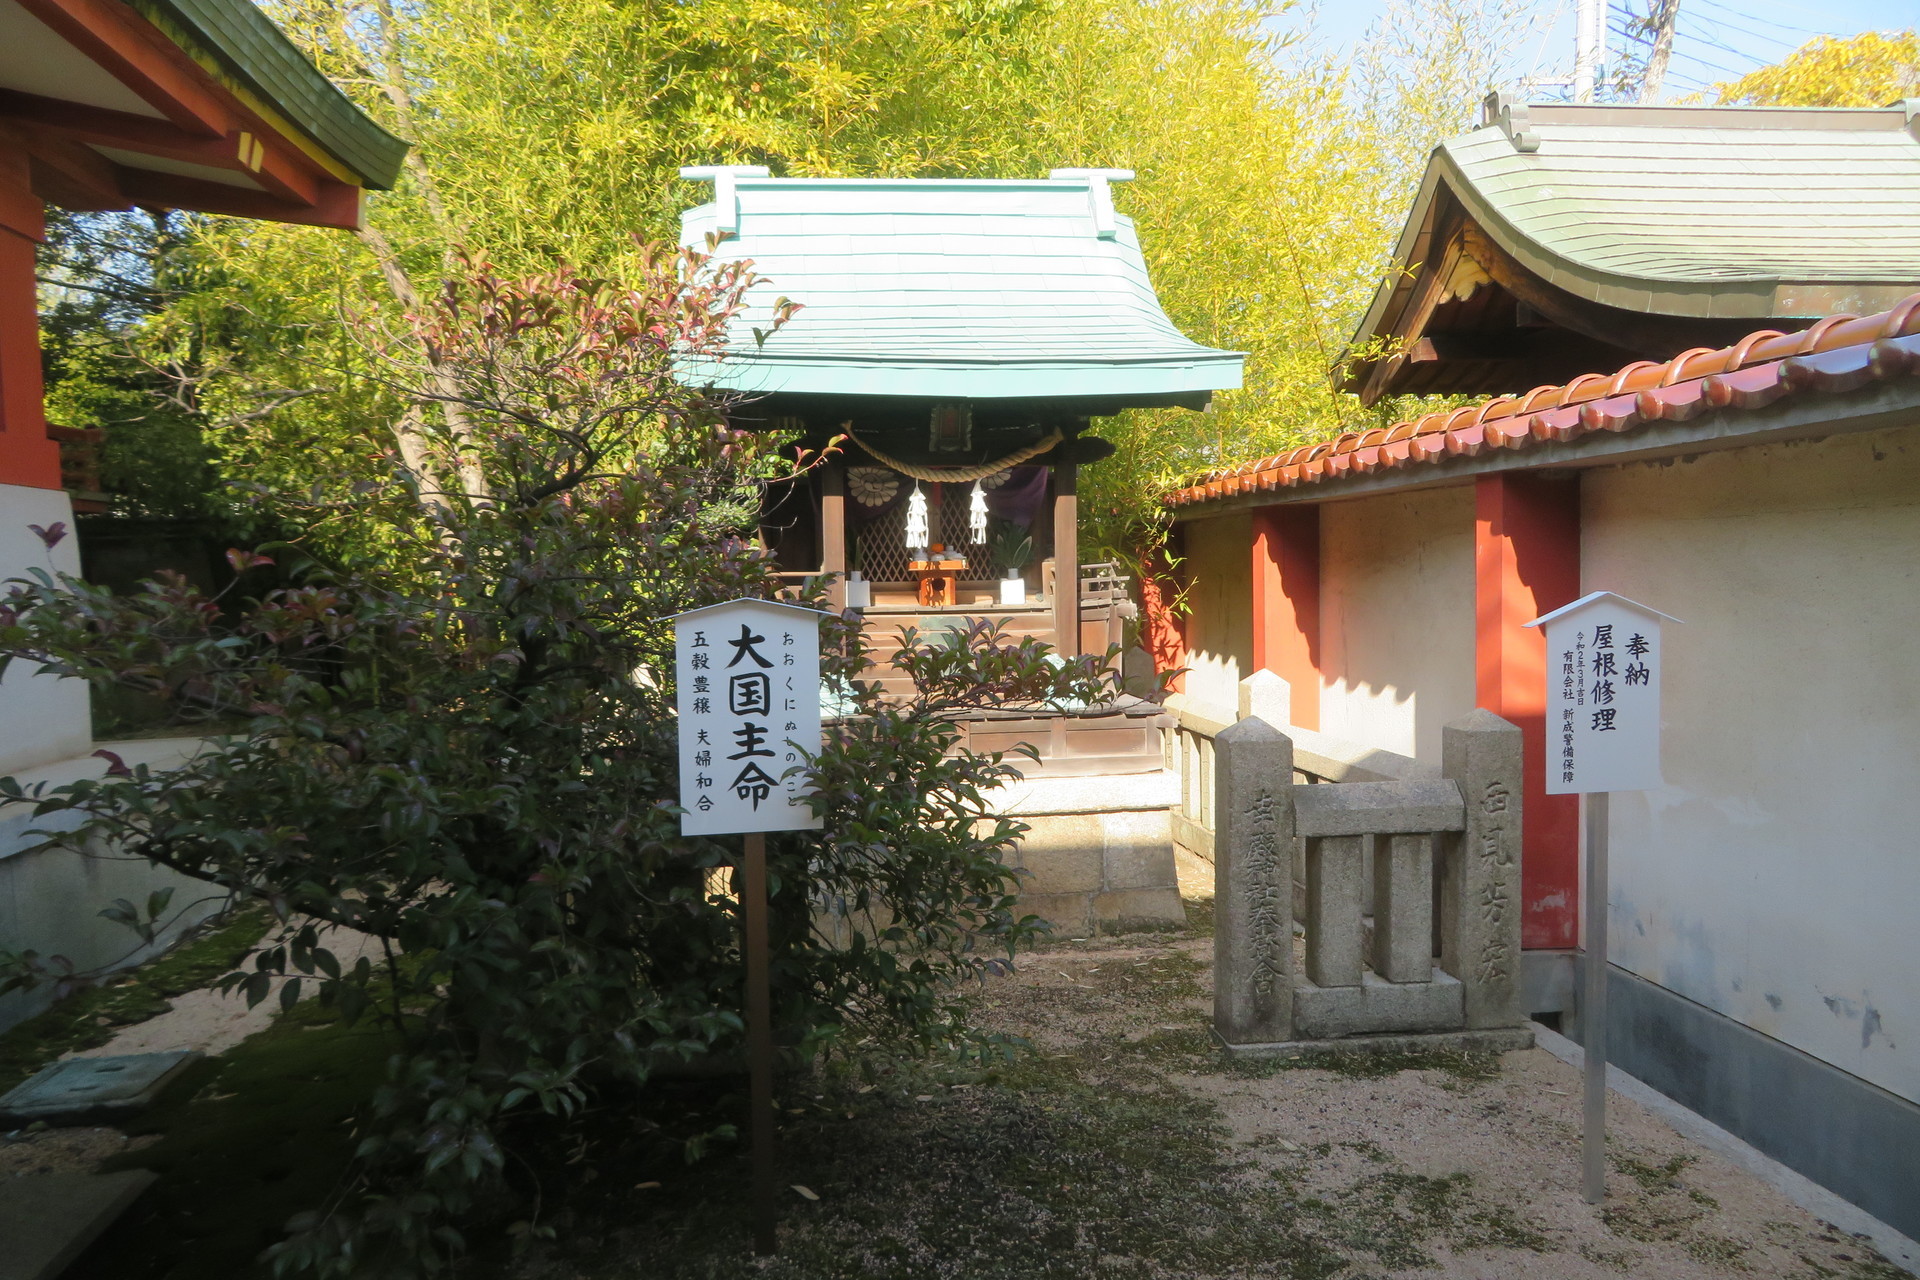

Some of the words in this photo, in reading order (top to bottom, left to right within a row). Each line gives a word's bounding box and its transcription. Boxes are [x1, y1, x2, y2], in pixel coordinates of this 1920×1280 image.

[690, 631, 711, 715] 五穀豊穣
[1562, 650, 1575, 700] 有限会社
[1590, 623, 1619, 732] 屋根修理
[1624, 632, 1650, 687] 奉納
[723, 623, 780, 813] 大国主命
[782, 631, 798, 807] おおくにぬしのこと
[694, 728, 715, 812] 夫婦和合
